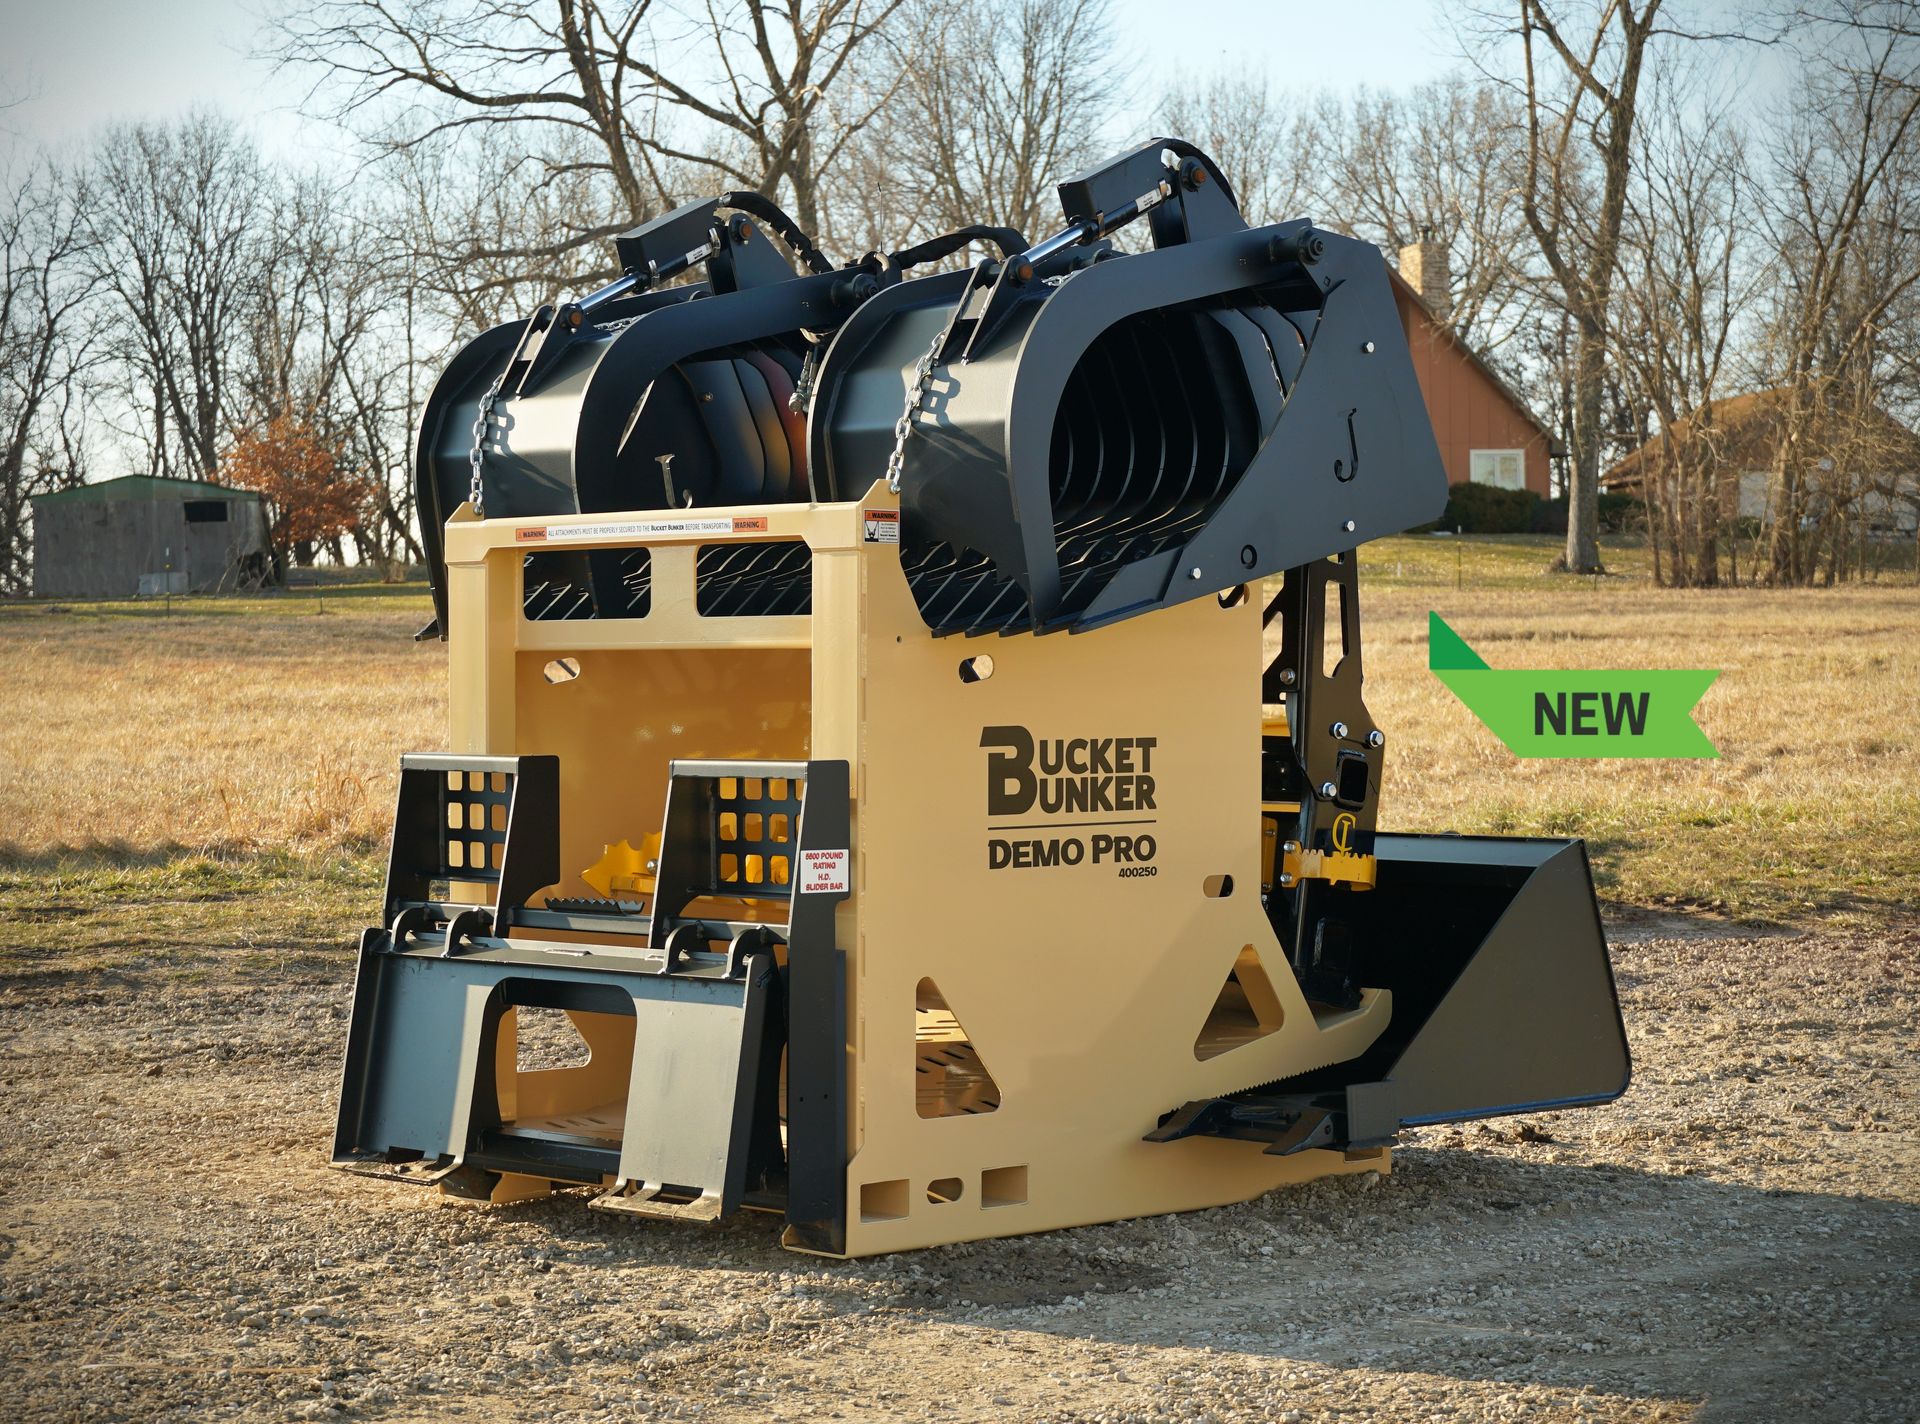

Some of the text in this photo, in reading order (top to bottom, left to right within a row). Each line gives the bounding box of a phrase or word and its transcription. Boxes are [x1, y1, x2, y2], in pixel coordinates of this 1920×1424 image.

[522, 531, 546, 539] WARNING
[555, 528, 582, 536] ATTACHMENTS
[582, 527, 593, 535] MUST
[599, 526, 618, 534] PROPERLY
[618, 525, 636, 533] SECURED
[685, 523, 700, 531] BEFORE
[701, 522, 731, 530] TRANSPORTING
[734, 521, 760, 529] WARNING
[821, 851, 844, 860] POUND
[988, 834, 1157, 870] DEMO PRO
[817, 873, 831, 881] H.D.
[1118, 866, 1158, 878] 400250
[805, 882, 844, 891] SLIDER BAR
